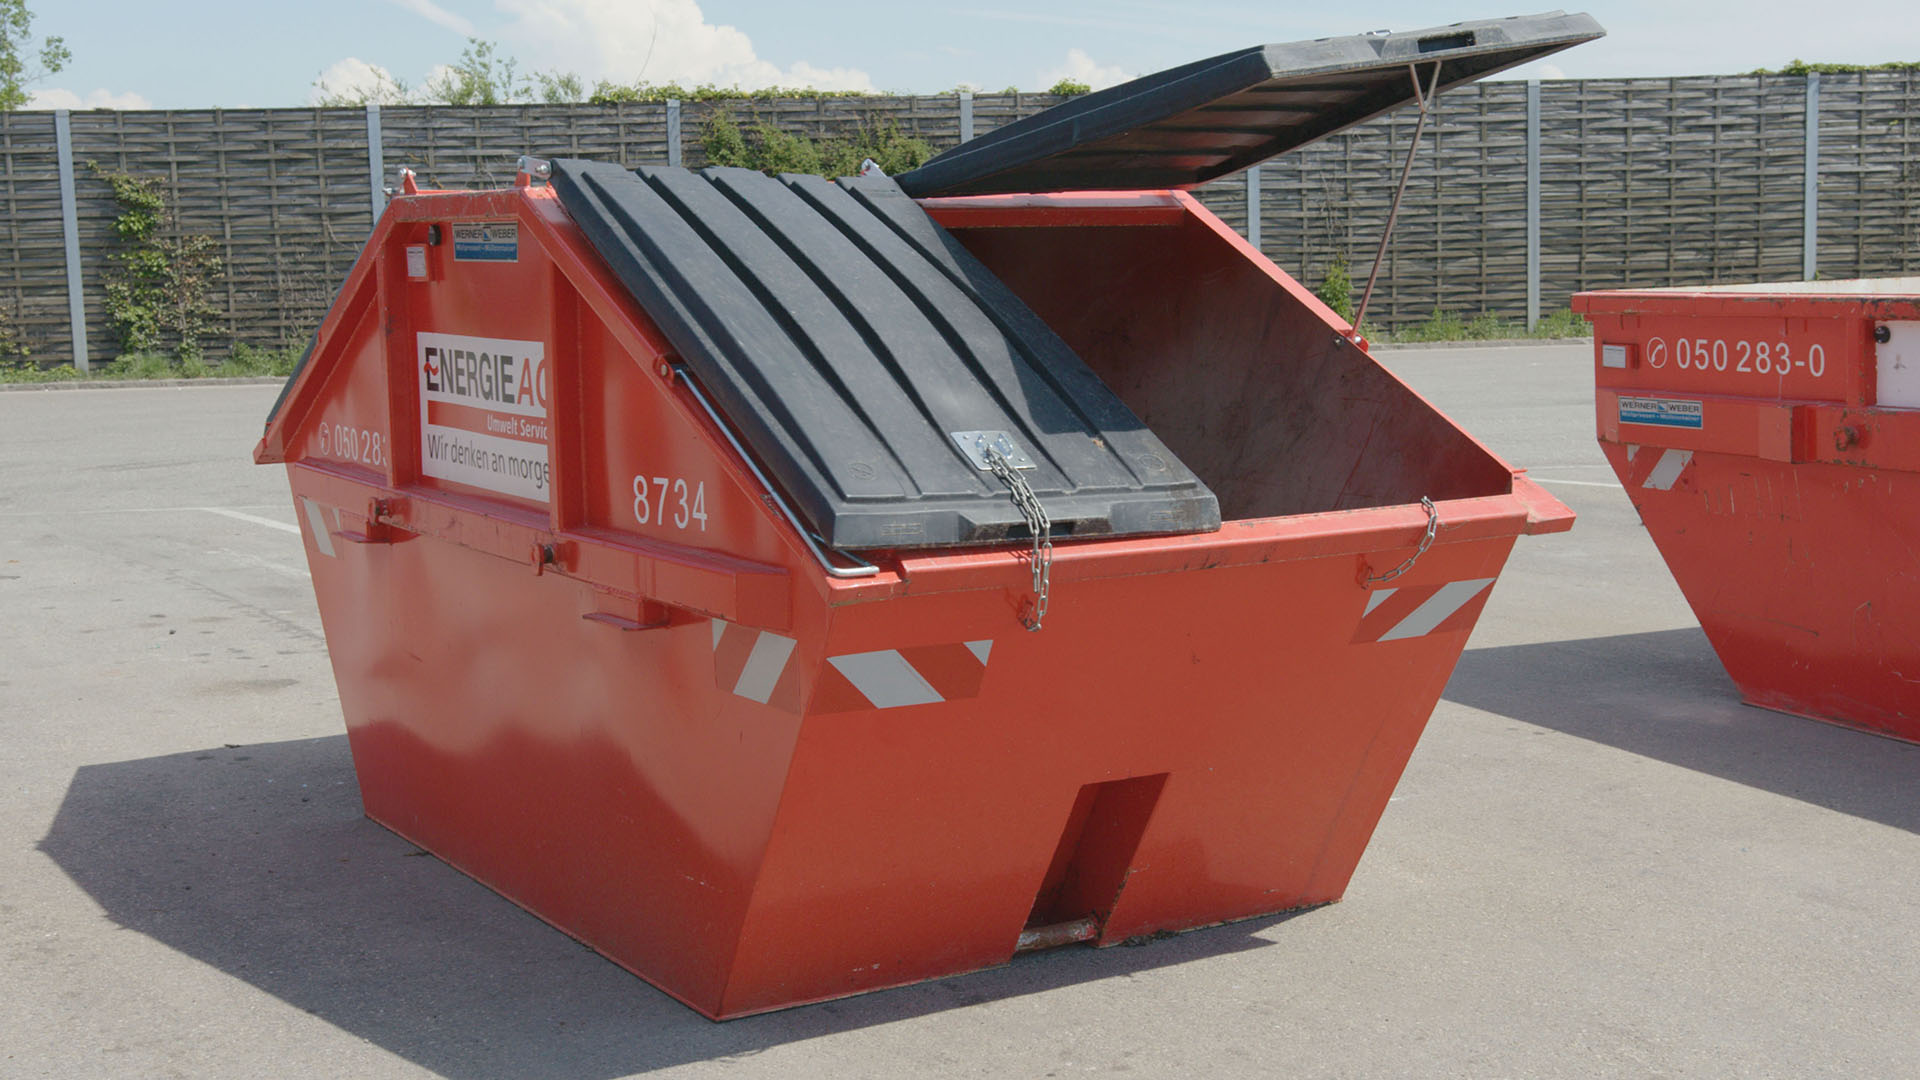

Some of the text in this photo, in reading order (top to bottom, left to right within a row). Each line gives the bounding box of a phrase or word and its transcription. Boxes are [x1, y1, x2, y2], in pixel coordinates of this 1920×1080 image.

[455, 228, 516, 239] WERNER WEBER
[424, 347, 515, 404] ENERGIE
[1676, 338, 1825, 377] 050 283-0
[487, 414, 518, 435] Umwelt
[1621, 400, 1700, 413] WERNER WEBER
[334, 424, 359, 461] 050
[427, 433, 448, 461] Wir
[451, 438, 489, 471] denken
[491, 451, 506, 474] an
[633, 474, 708, 532] 8734
